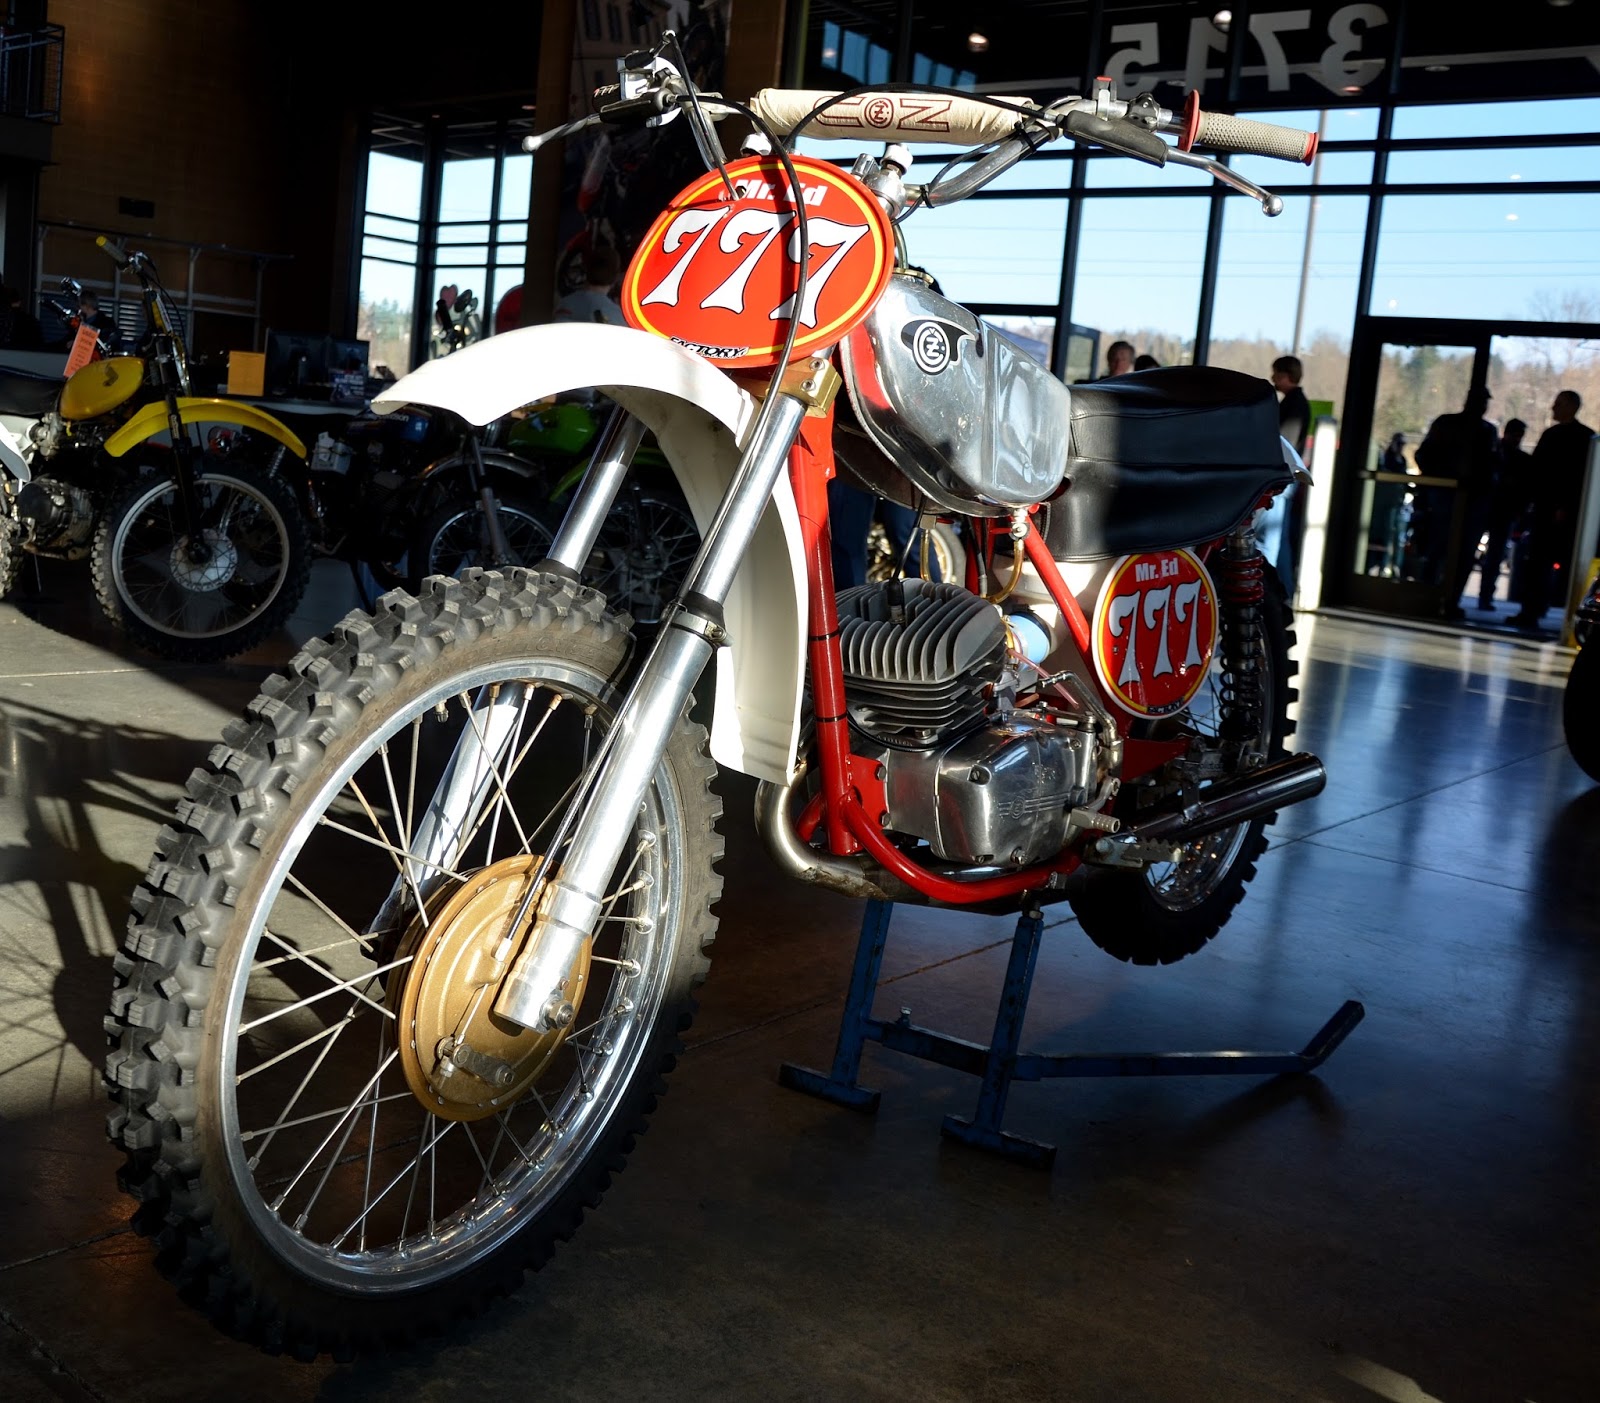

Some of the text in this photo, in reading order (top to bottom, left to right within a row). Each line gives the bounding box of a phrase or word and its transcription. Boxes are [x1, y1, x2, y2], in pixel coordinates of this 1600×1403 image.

[735, 179, 776, 201] Mr.
[641, 205, 870, 329] 777
[1135, 557, 1179, 583] Mr. Ed
[1108, 578, 1202, 687] 777
